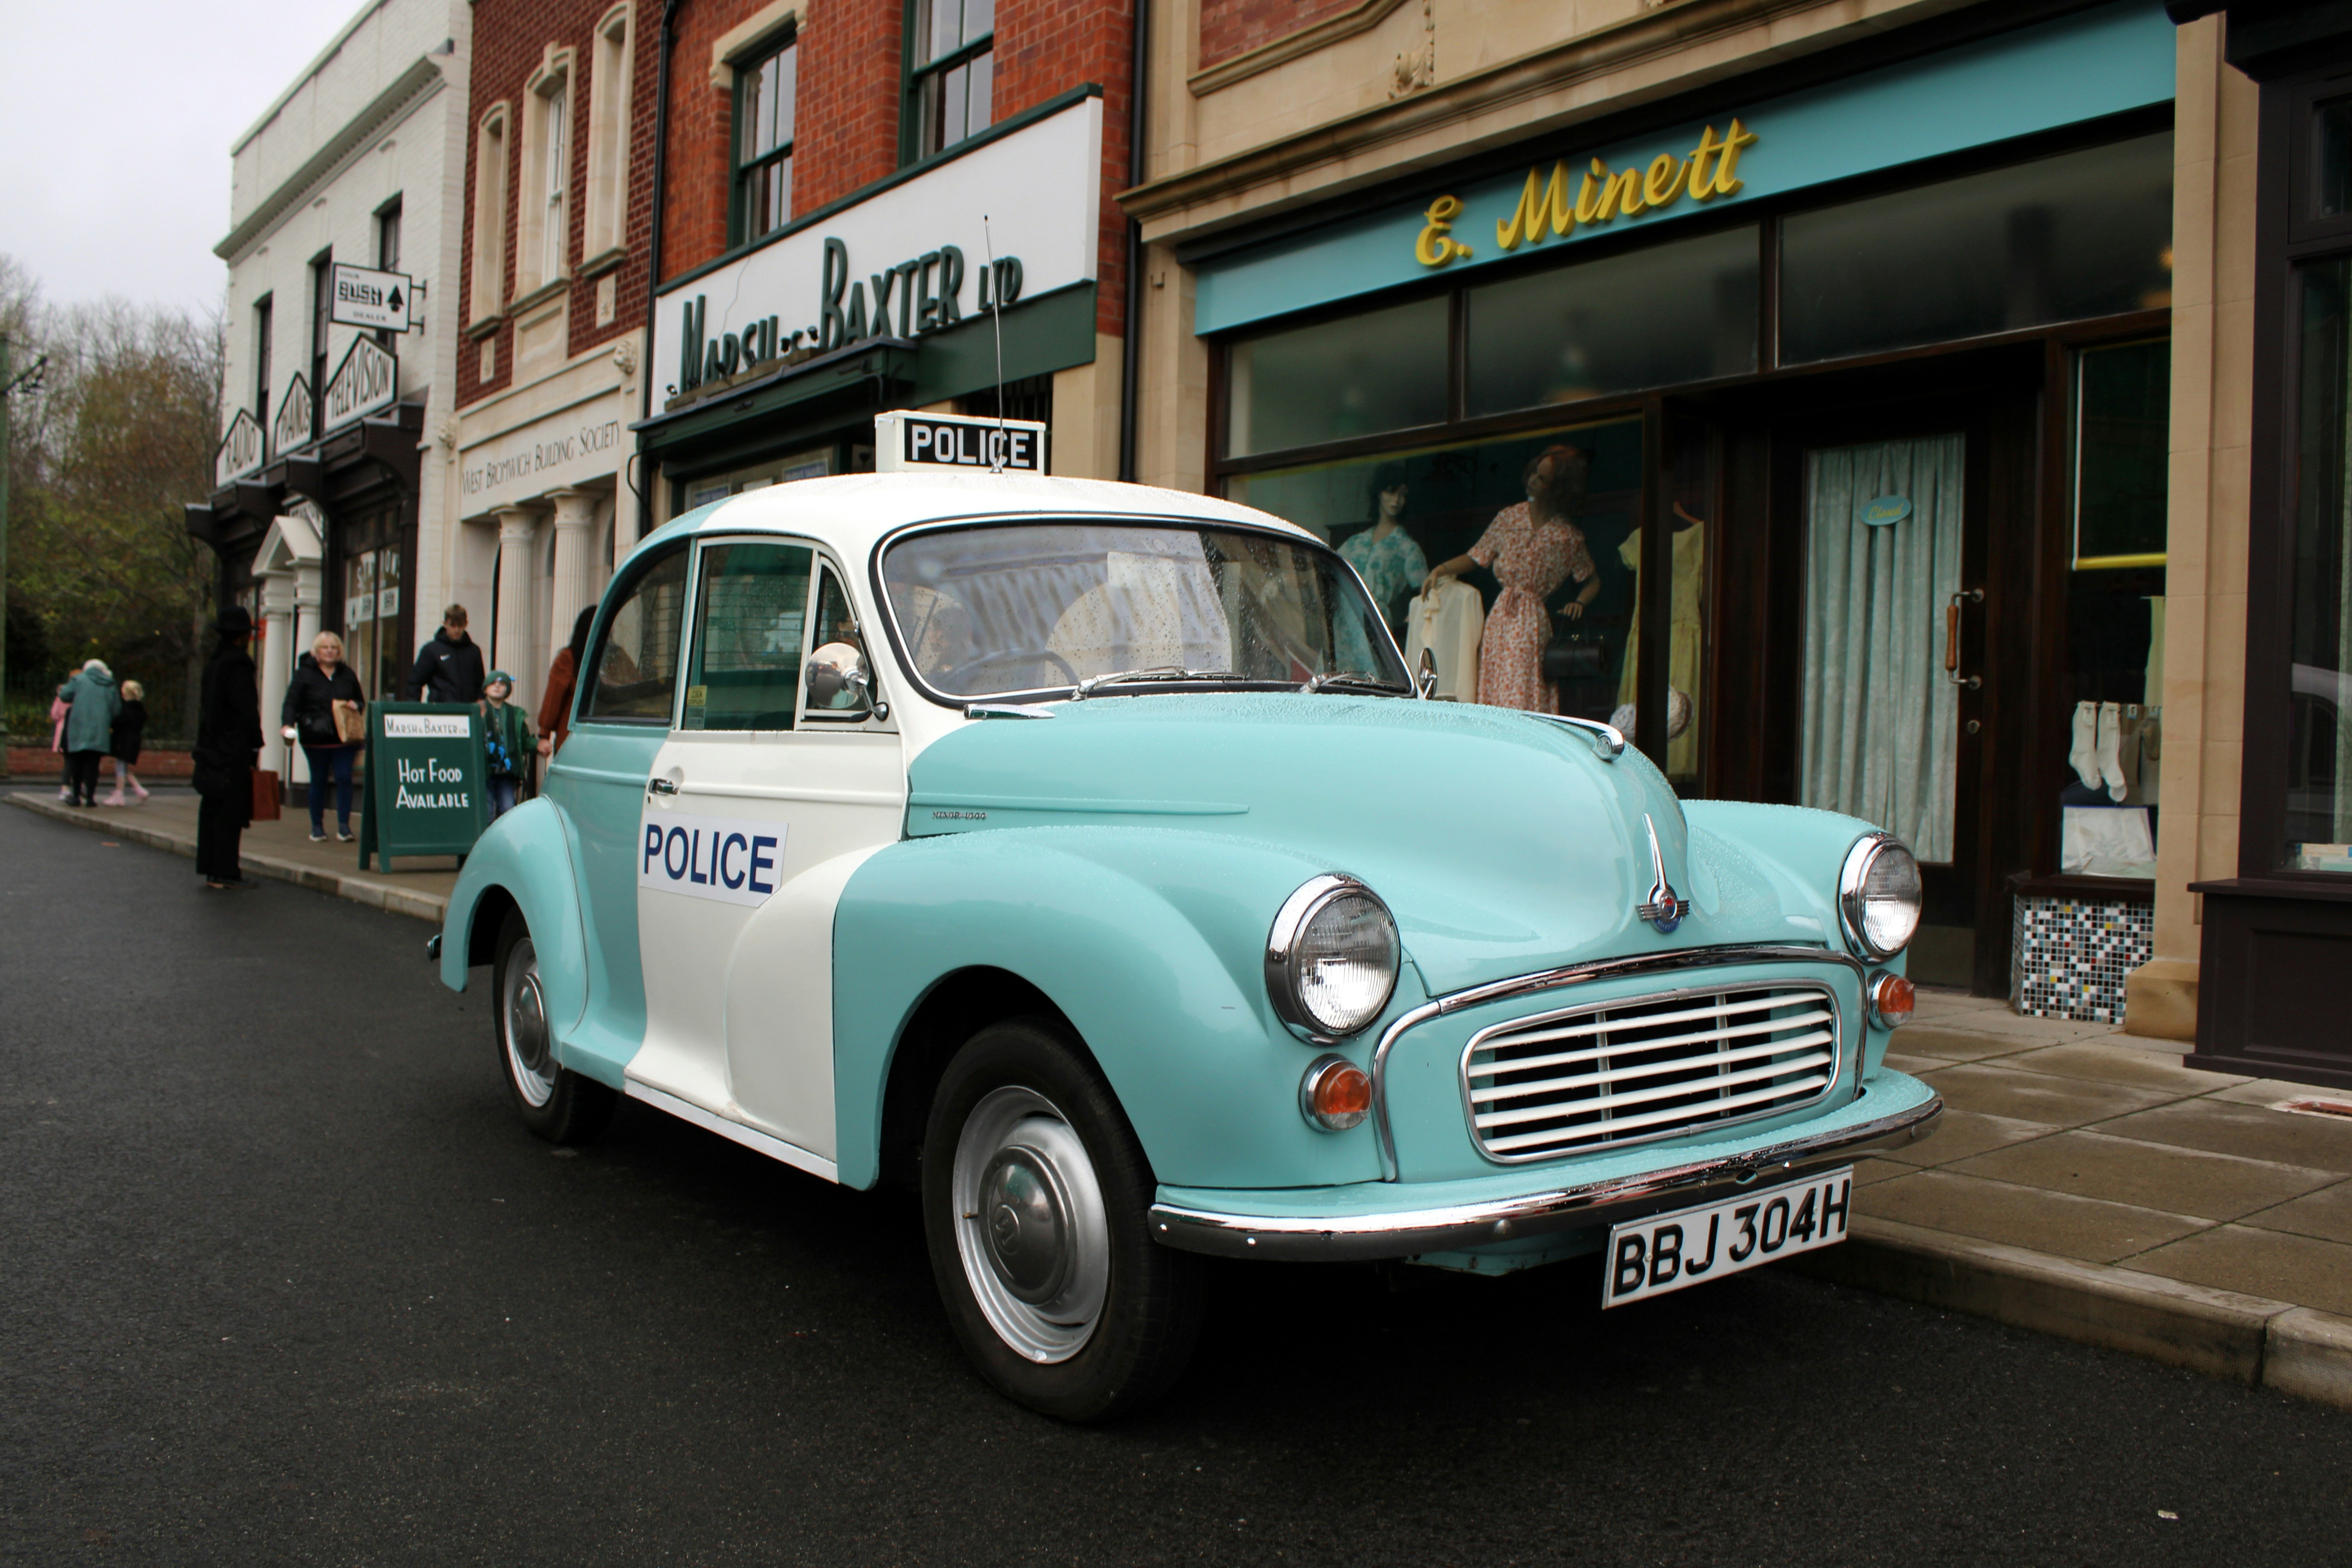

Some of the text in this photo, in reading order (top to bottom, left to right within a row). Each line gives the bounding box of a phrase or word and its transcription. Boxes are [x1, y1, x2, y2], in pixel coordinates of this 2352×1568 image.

[1416, 118, 1759, 267] E. Minett
[338, 281, 382, 306] BUSH
[819, 236, 964, 350] BAXTER
[978, 256, 1023, 312] LTD
[353, 310, 386, 321] DEALER
[331, 341, 390, 420] TELEVISION
[225, 418, 256, 477] RADIO
[462, 419, 620, 495] WEST BROMWICH BUILDING SOCIETY
[912, 424, 1030, 467] POLICE
[1867, 502, 1904, 520] Closed
[386, 718, 417, 733] MARSH
[424, 718, 457, 734] BAXTER
[397, 758, 463, 783] HOT FOOD
[395, 784, 470, 809] AVAILABLE
[965, 811, 986, 820] 1000
[644, 824, 777, 894] POLICE
[1613, 1178, 1850, 1297] BBJ 304H
